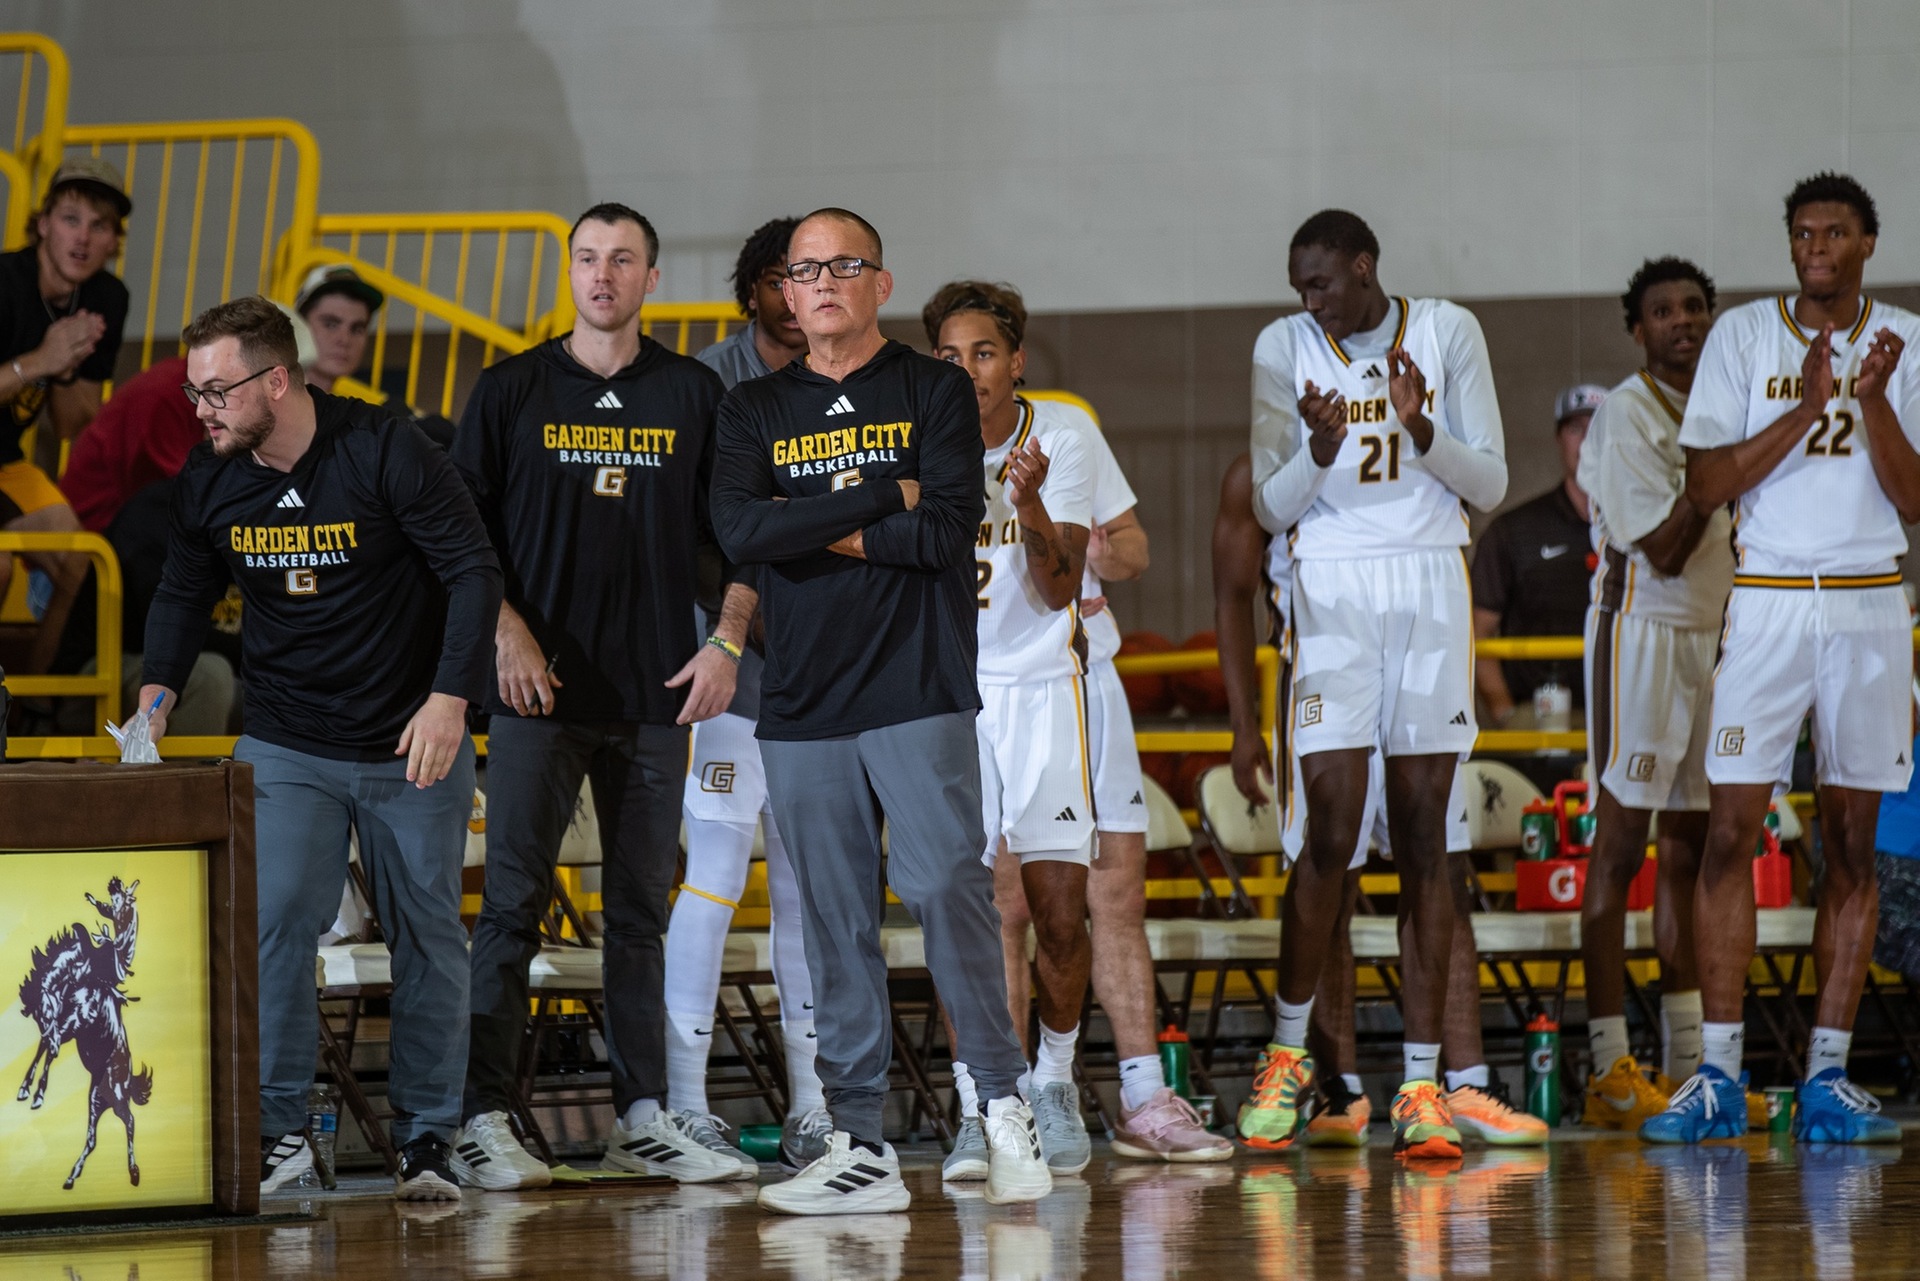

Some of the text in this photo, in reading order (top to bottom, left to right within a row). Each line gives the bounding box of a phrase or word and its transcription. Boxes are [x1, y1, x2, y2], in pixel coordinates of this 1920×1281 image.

[1766, 376, 1842, 399] GARN
[1344, 398, 1387, 424] DEN
[543, 423, 676, 455] GARDEN CITY
[773, 421, 912, 466] GARDEN CITY
[1805, 411, 1854, 457] 22
[559, 449, 662, 467] BASKETBALL
[789, 449, 898, 478] BASKETBALL
[1358, 432, 1400, 485] 21
[592, 466, 628, 497] G
[230, 521, 358, 553] GARDEN CITY
[244, 551, 350, 568] BASKETBALL
[285, 568, 318, 596] G
[700, 761, 737, 794] G
[1548, 866, 1577, 903] G
[1530, 1047, 1554, 1074] G
